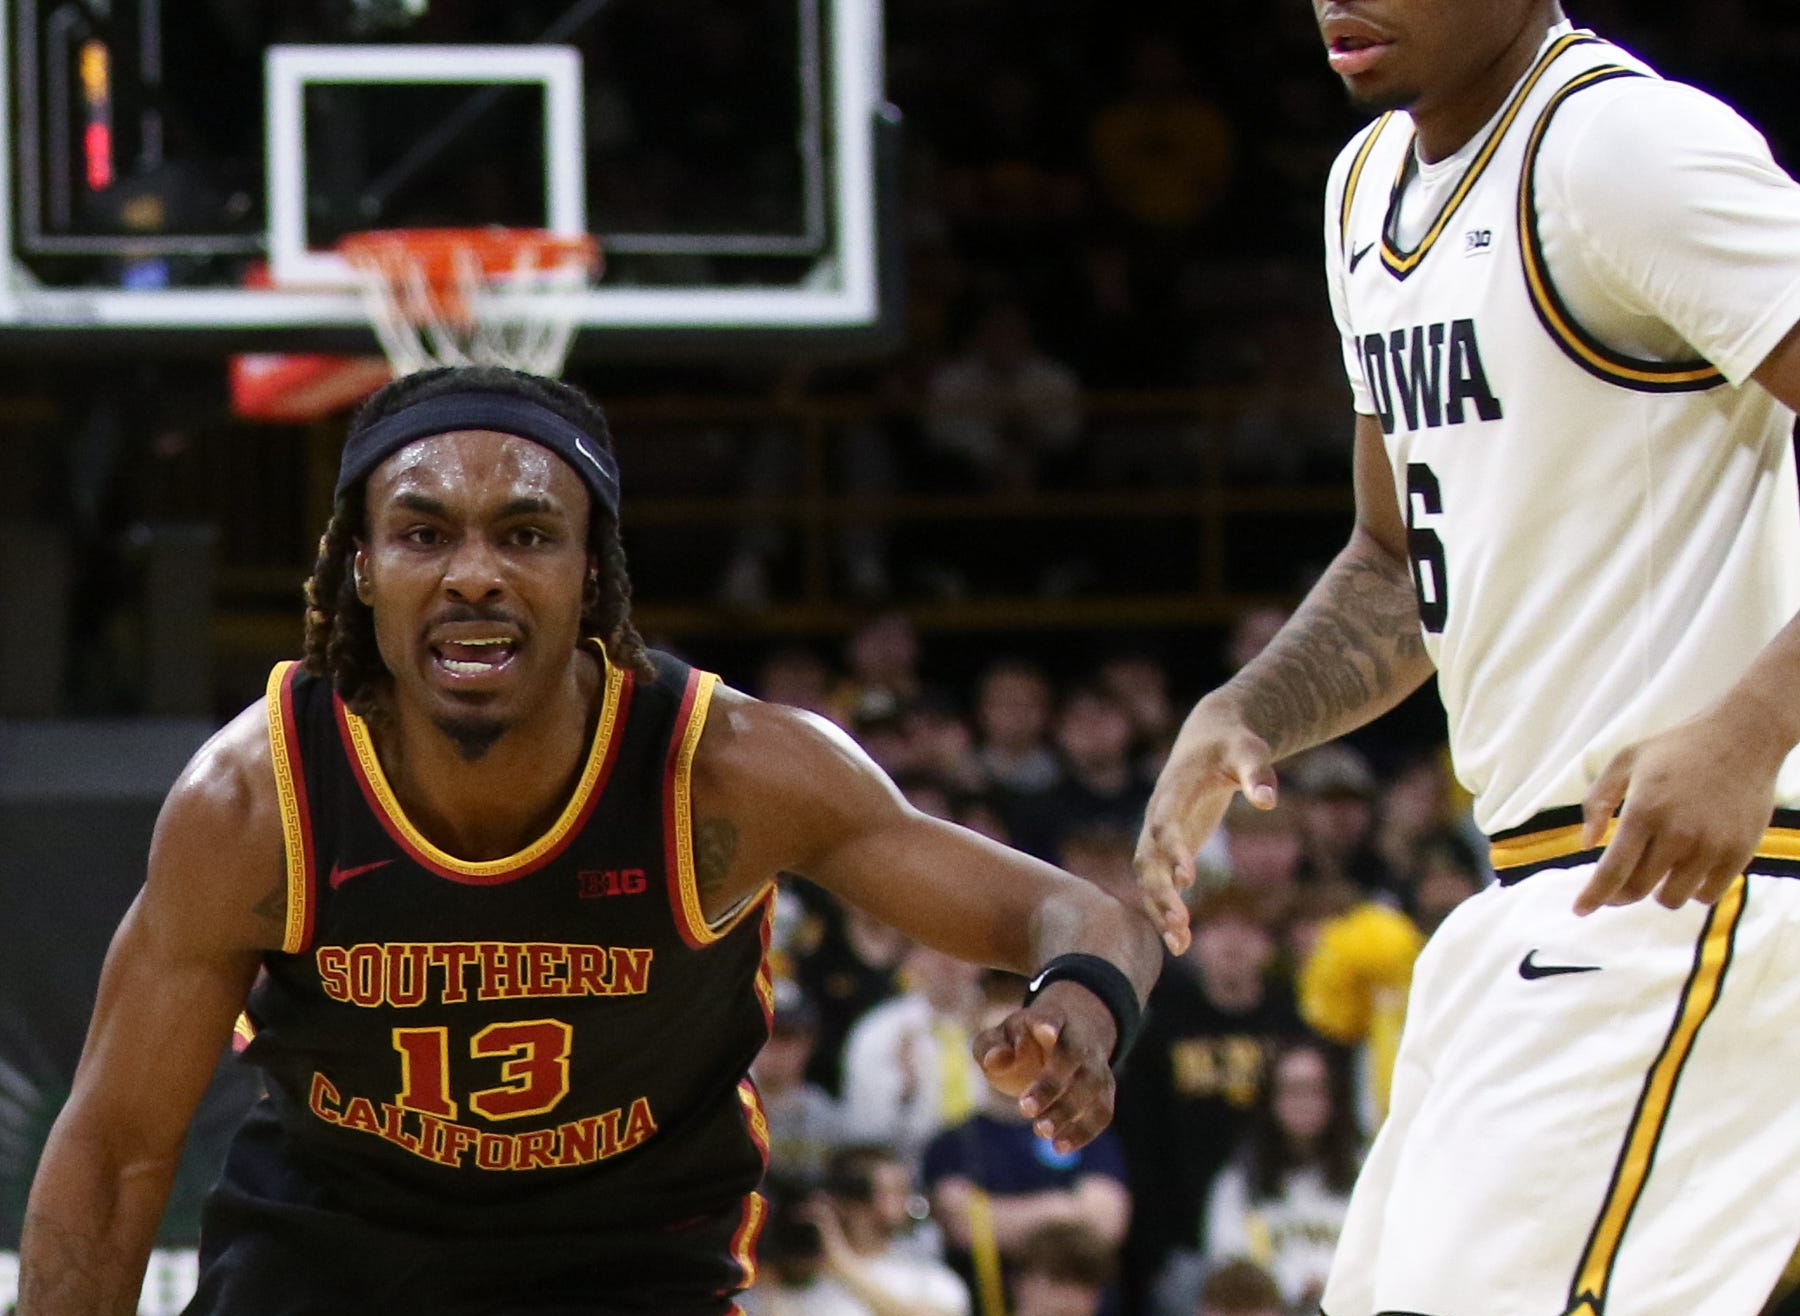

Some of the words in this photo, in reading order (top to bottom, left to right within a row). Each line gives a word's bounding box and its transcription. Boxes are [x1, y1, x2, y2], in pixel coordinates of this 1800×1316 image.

[1406, 462, 1449, 633] 6
[316, 942, 653, 1008] SOUTHERN
[392, 1018, 574, 1121] 13
[309, 1071, 658, 1171] CALIFORNIA
